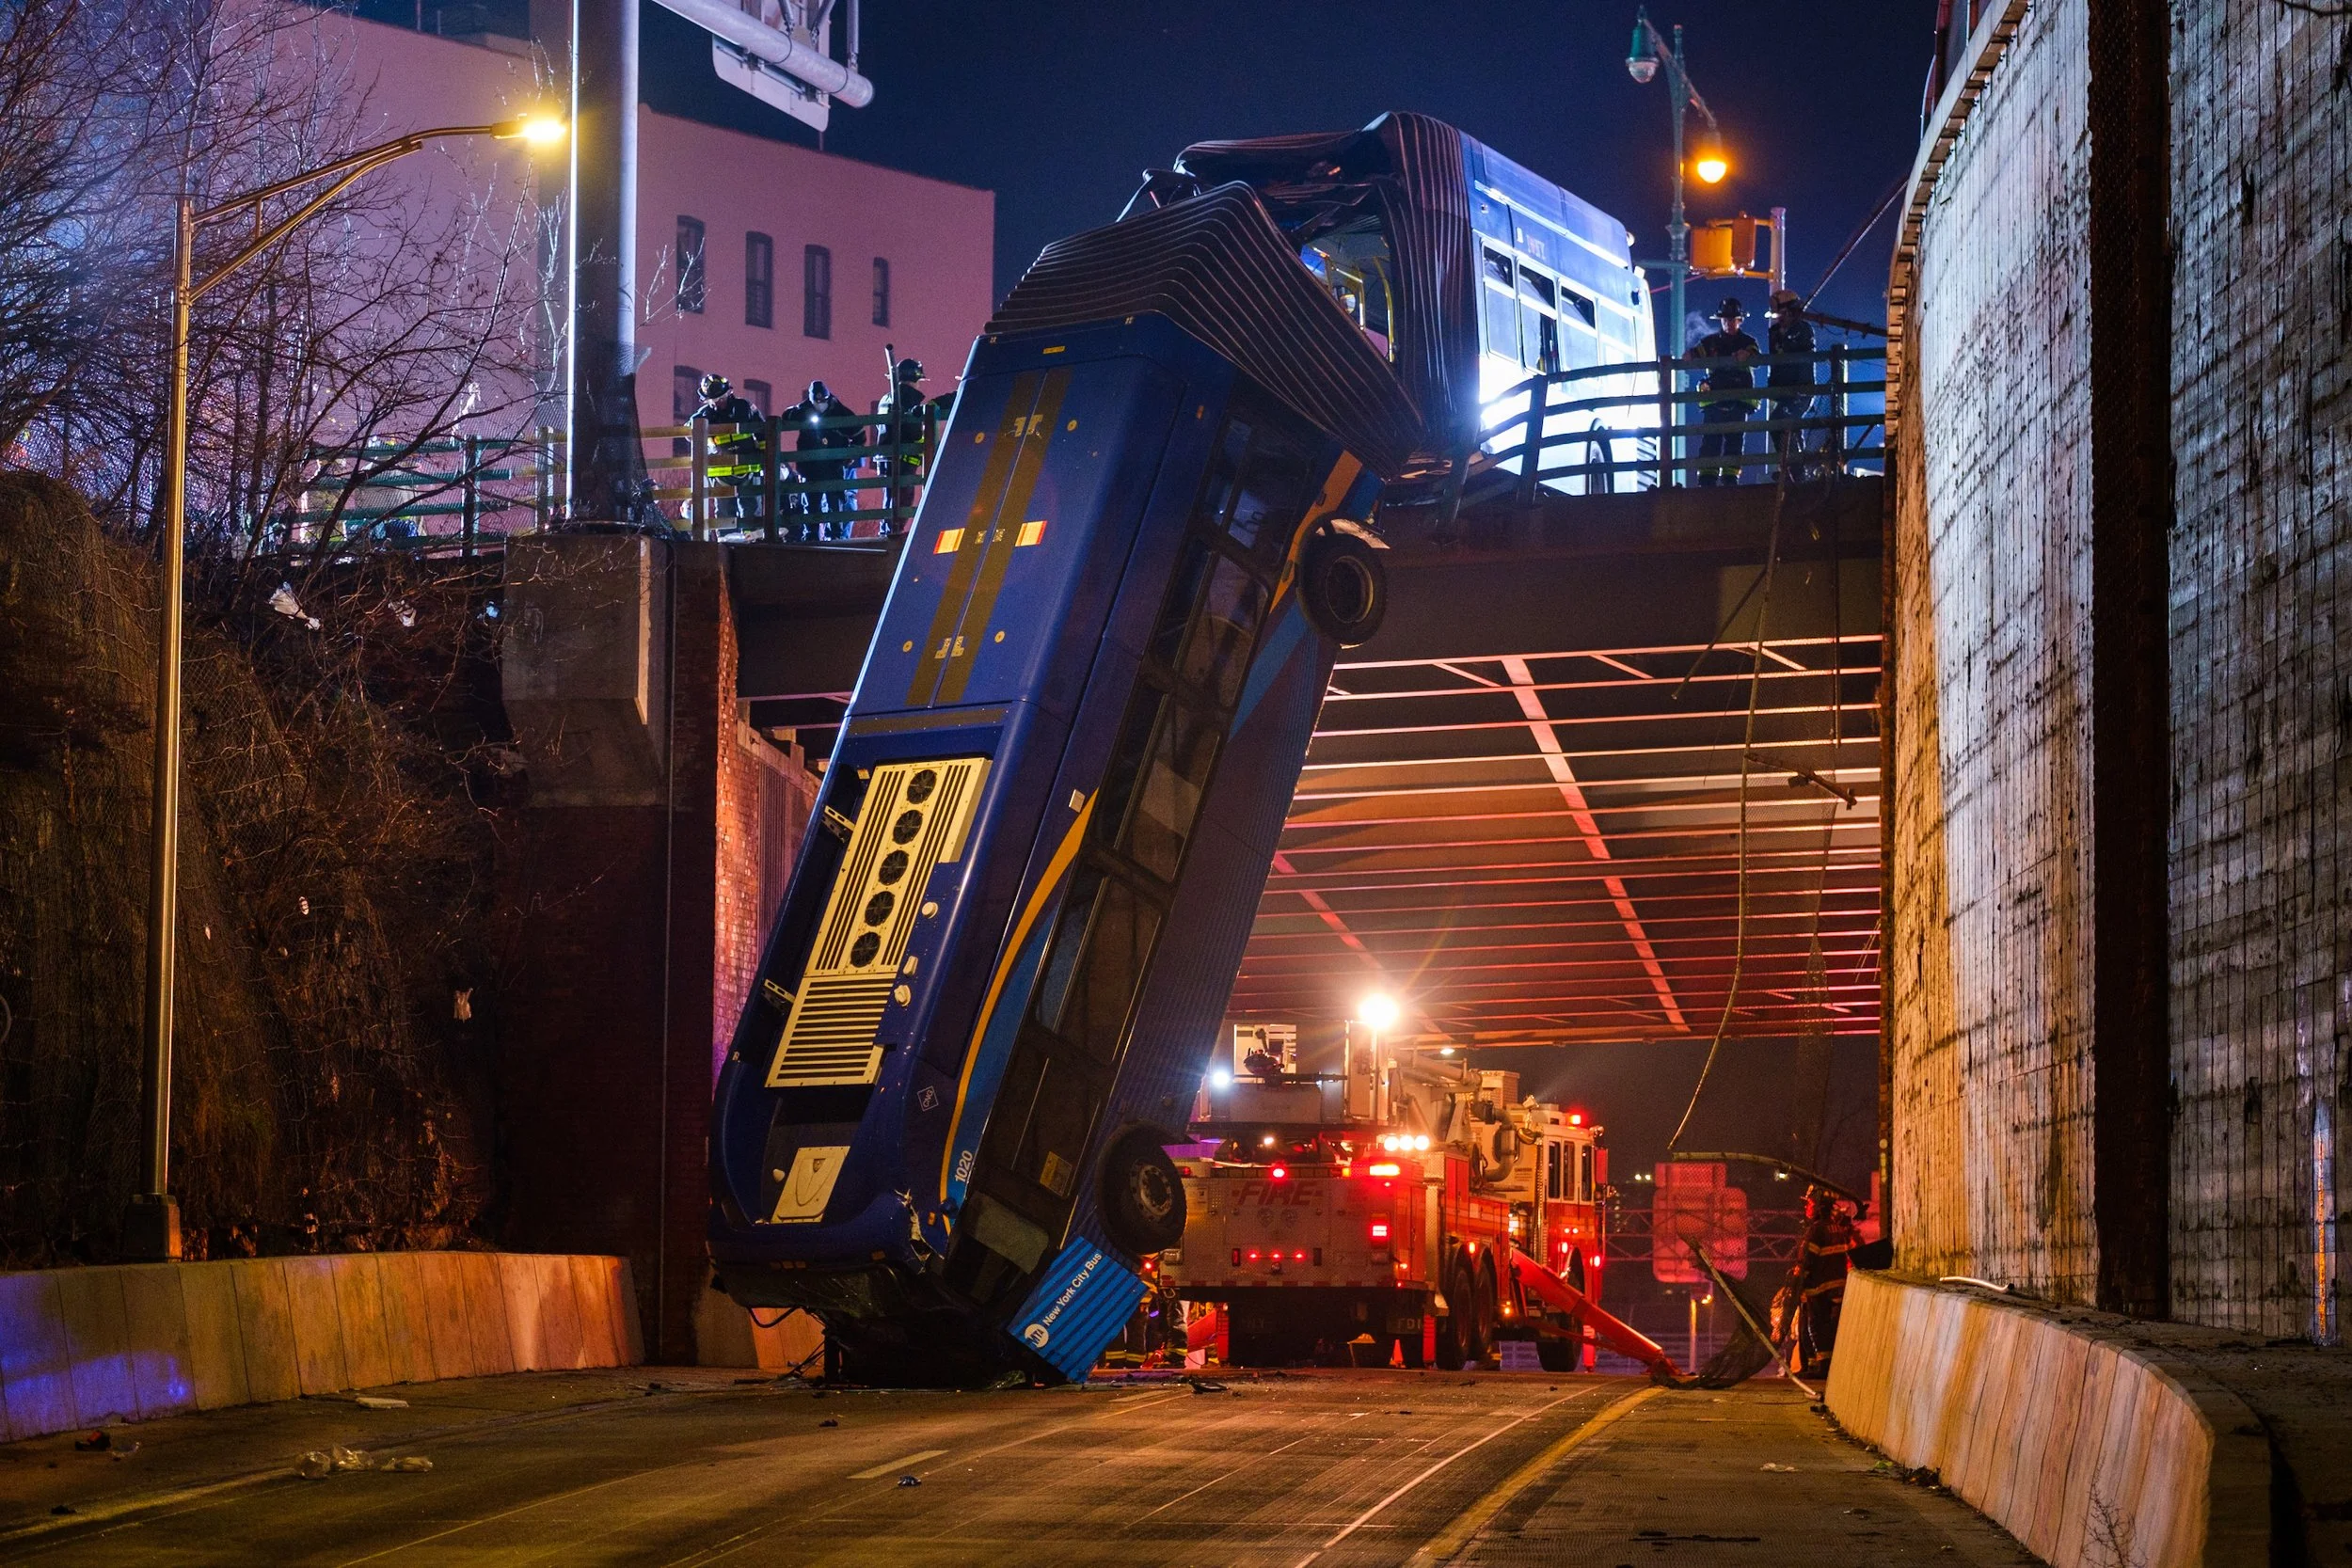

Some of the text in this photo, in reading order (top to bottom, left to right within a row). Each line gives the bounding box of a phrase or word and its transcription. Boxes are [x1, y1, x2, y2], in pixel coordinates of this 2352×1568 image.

[955, 1149, 973, 1182] 1020
[1238, 1180, 1318, 1206] FIRE
[1042, 1304, 1061, 1326] New
[1056, 1287, 1076, 1307] York
[1072, 1270, 1090, 1287] City
[1085, 1253, 1103, 1271] Bus
